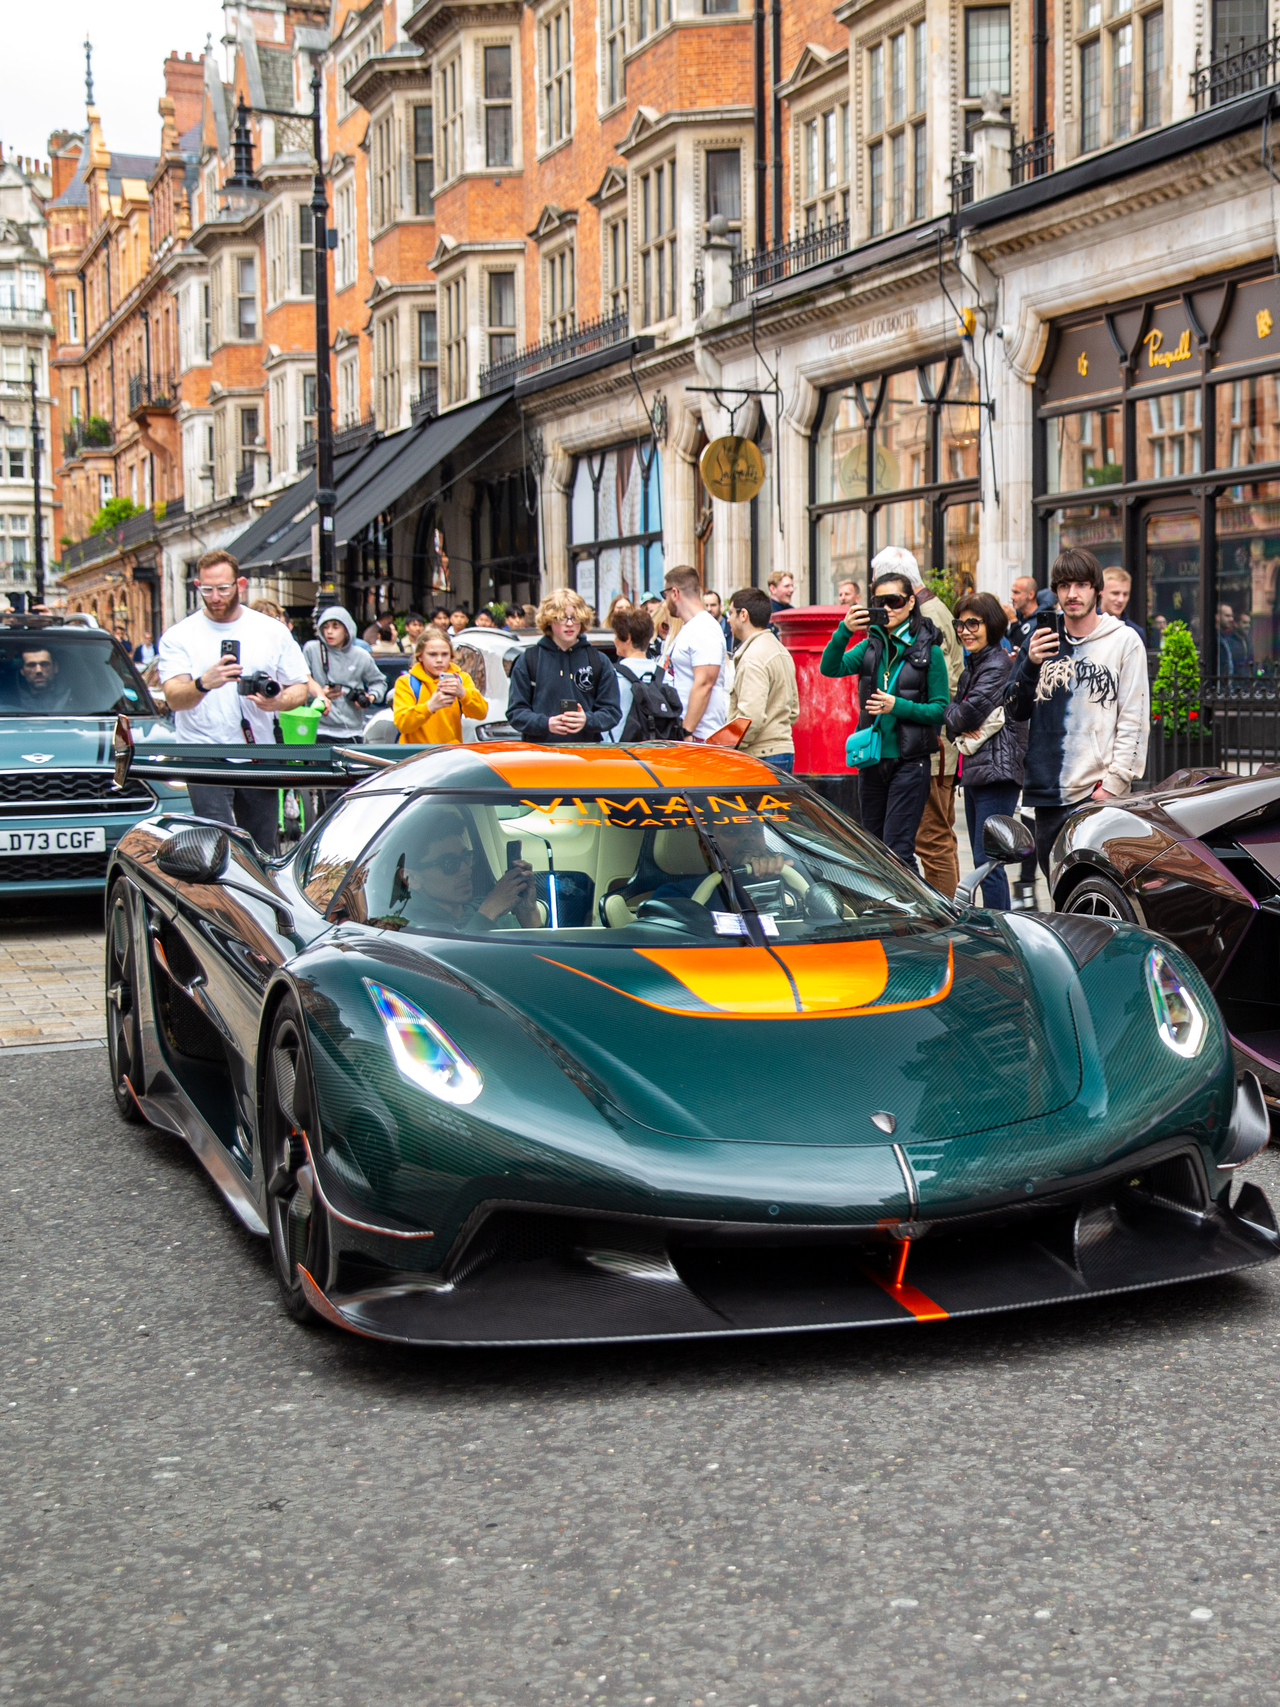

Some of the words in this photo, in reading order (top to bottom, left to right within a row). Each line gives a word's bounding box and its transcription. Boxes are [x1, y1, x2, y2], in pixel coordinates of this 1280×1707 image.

[1144, 327, 1192, 368] Pragnell
[520, 794, 793, 815] VIMANA
[549, 817, 708, 827] PRIVATE
[713, 814, 791, 825] JETS
[56, 831, 96, 849] CGF
